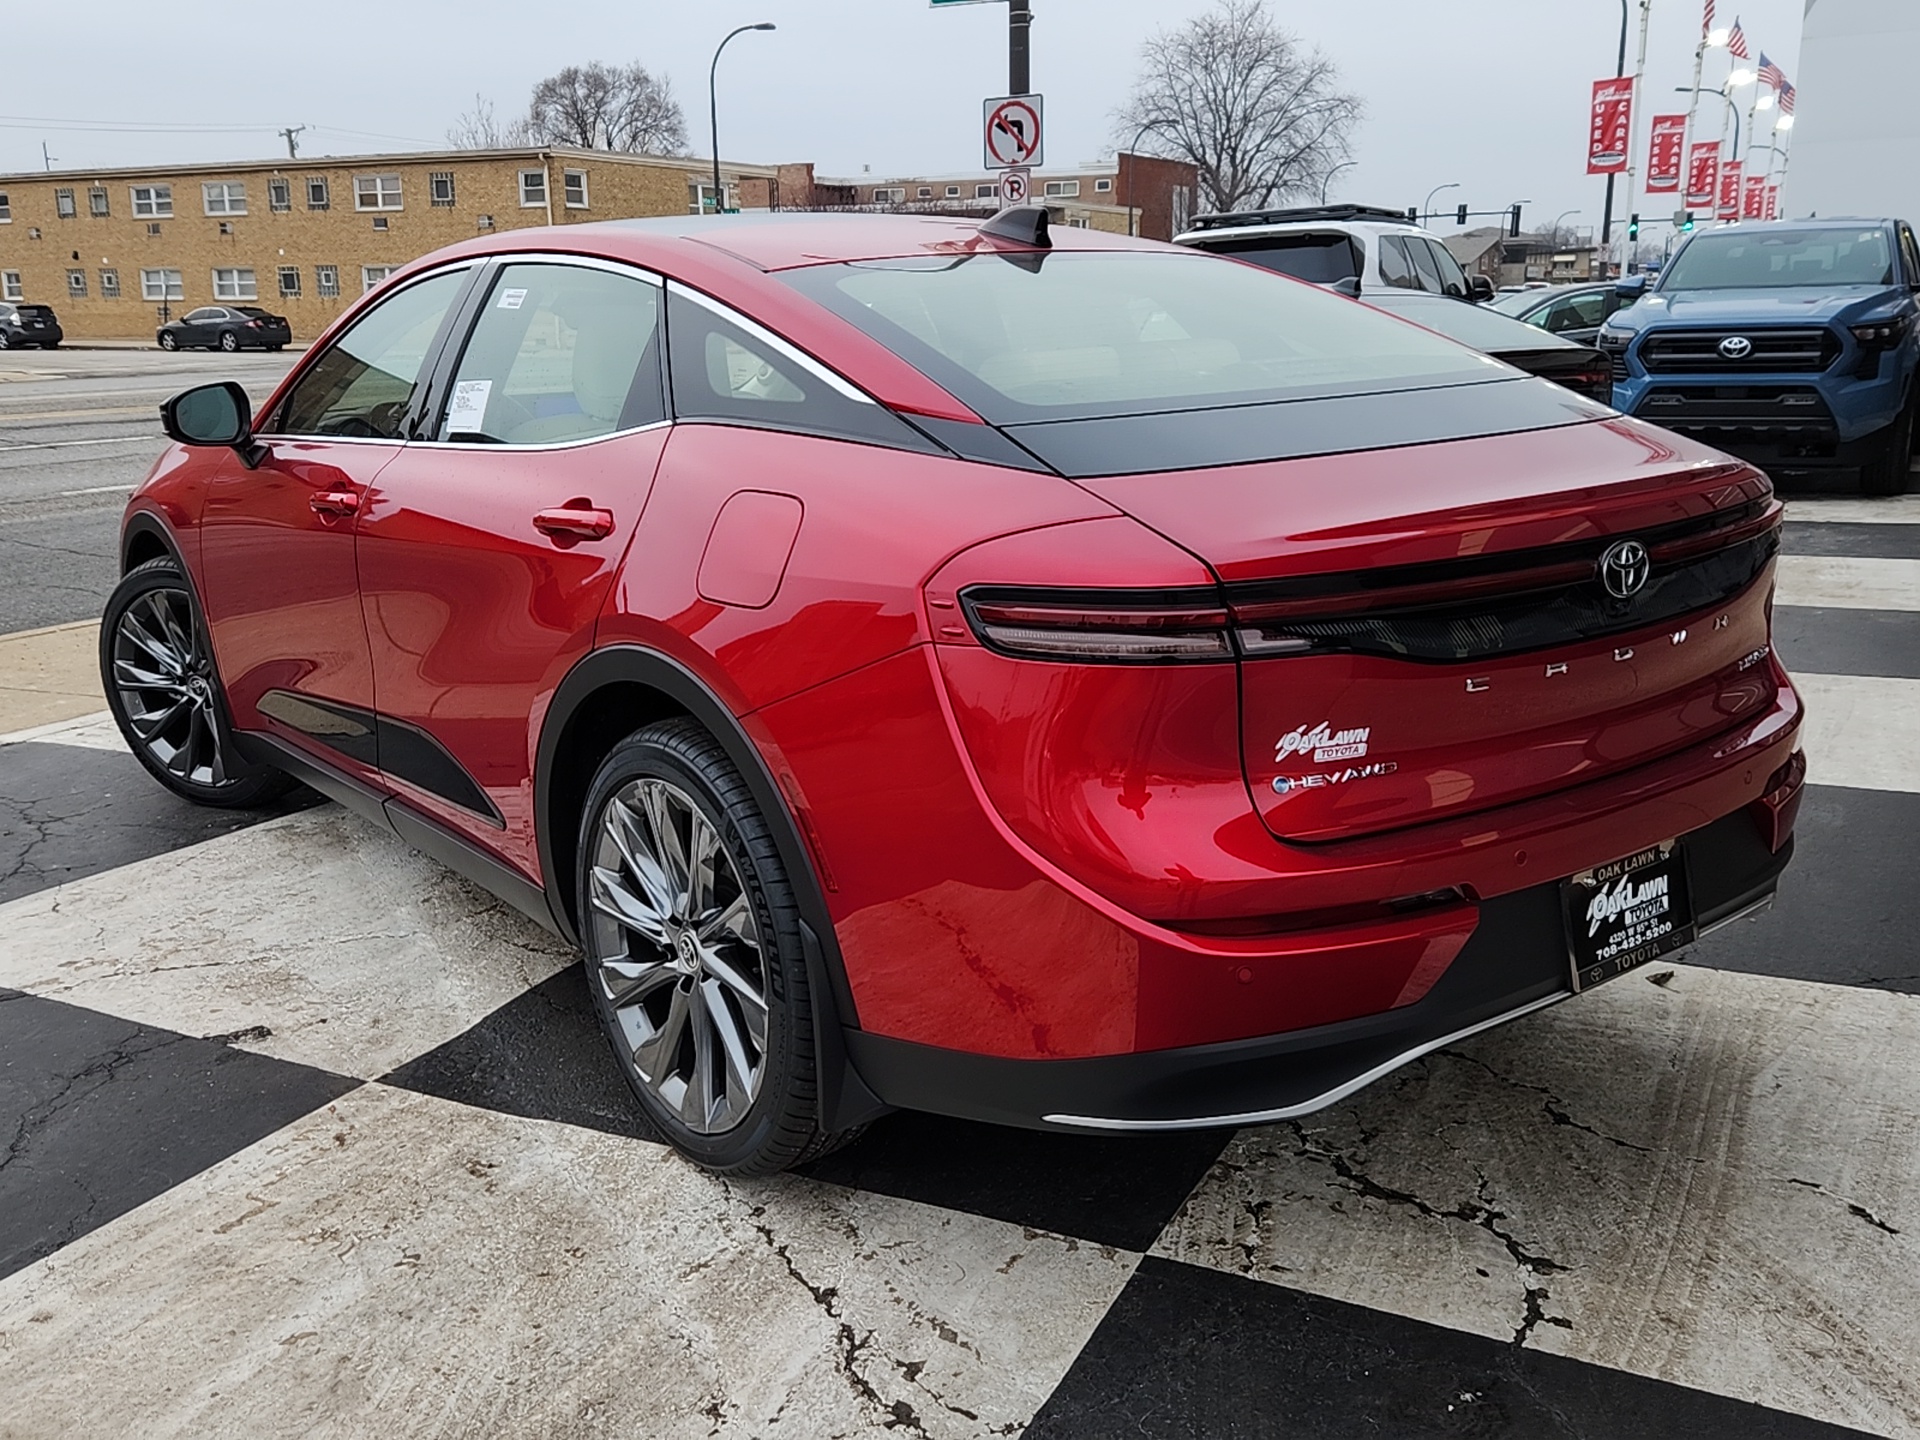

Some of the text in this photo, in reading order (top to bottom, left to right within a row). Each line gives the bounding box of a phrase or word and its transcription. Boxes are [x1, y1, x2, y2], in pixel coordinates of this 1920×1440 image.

[1593, 103, 1605, 152] USED
[1614, 101, 1628, 150] CARS
[1650, 135, 1662, 175] USED
[1669, 135, 1681, 174] CARS
[1689, 159, 1700, 193] USED
[1704, 158, 1716, 192] CARS
[1321, 745, 1360, 758] TOYOTA
[1597, 849, 1656, 882] OAK LAWN
[740, 856, 786, 999] MICHELIN
[1629, 900, 1665, 923] TOYOTA
[1596, 921, 1673, 961] 708-423-5200
[1609, 930, 1627, 944] 4320
[1627, 926, 1635, 937] W
[1615, 943, 1661, 971] TOYOTA
